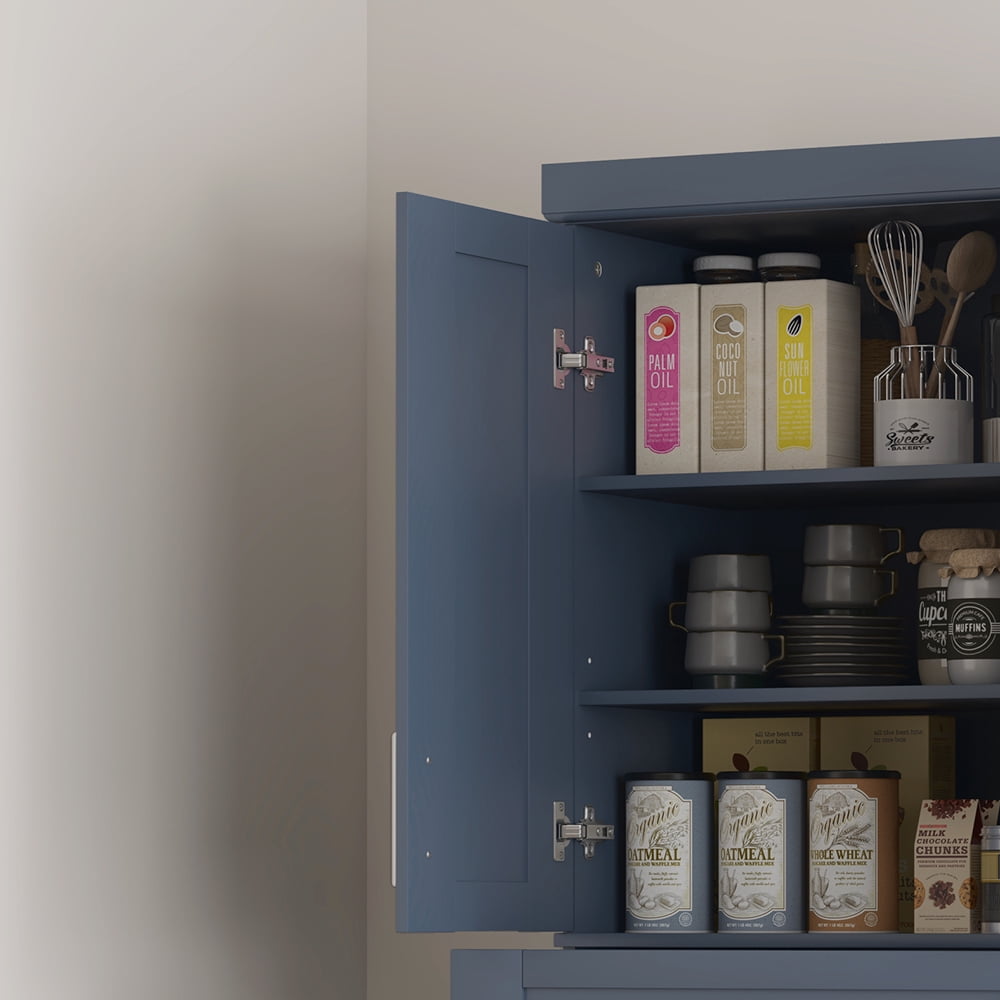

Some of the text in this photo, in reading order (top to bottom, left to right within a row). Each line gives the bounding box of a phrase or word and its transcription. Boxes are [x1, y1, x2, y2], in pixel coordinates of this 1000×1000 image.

[716, 343, 740, 359] COCO
[784, 343, 804, 359] SUN
[649, 354, 675, 371] PALM
[719, 361, 738, 377] NUT
[779, 360, 809, 377] FLOWER
[650, 371, 674, 389] OIL
[717, 378, 740, 395] OIL
[783, 378, 806, 395] OIL
[885, 432, 935, 448] Sweets
[919, 601, 948, 627] Cupc
[955, 622, 987, 633] MUFFINS
[720, 800, 773, 846] Organic
[811, 799, 866, 843] Organic
[627, 848, 682, 861] OATMEAL
[720, 848, 775, 861] OATMEAL
[836, 849, 873, 860] WHEAT
[916, 846, 968, 855] CHUNKS
